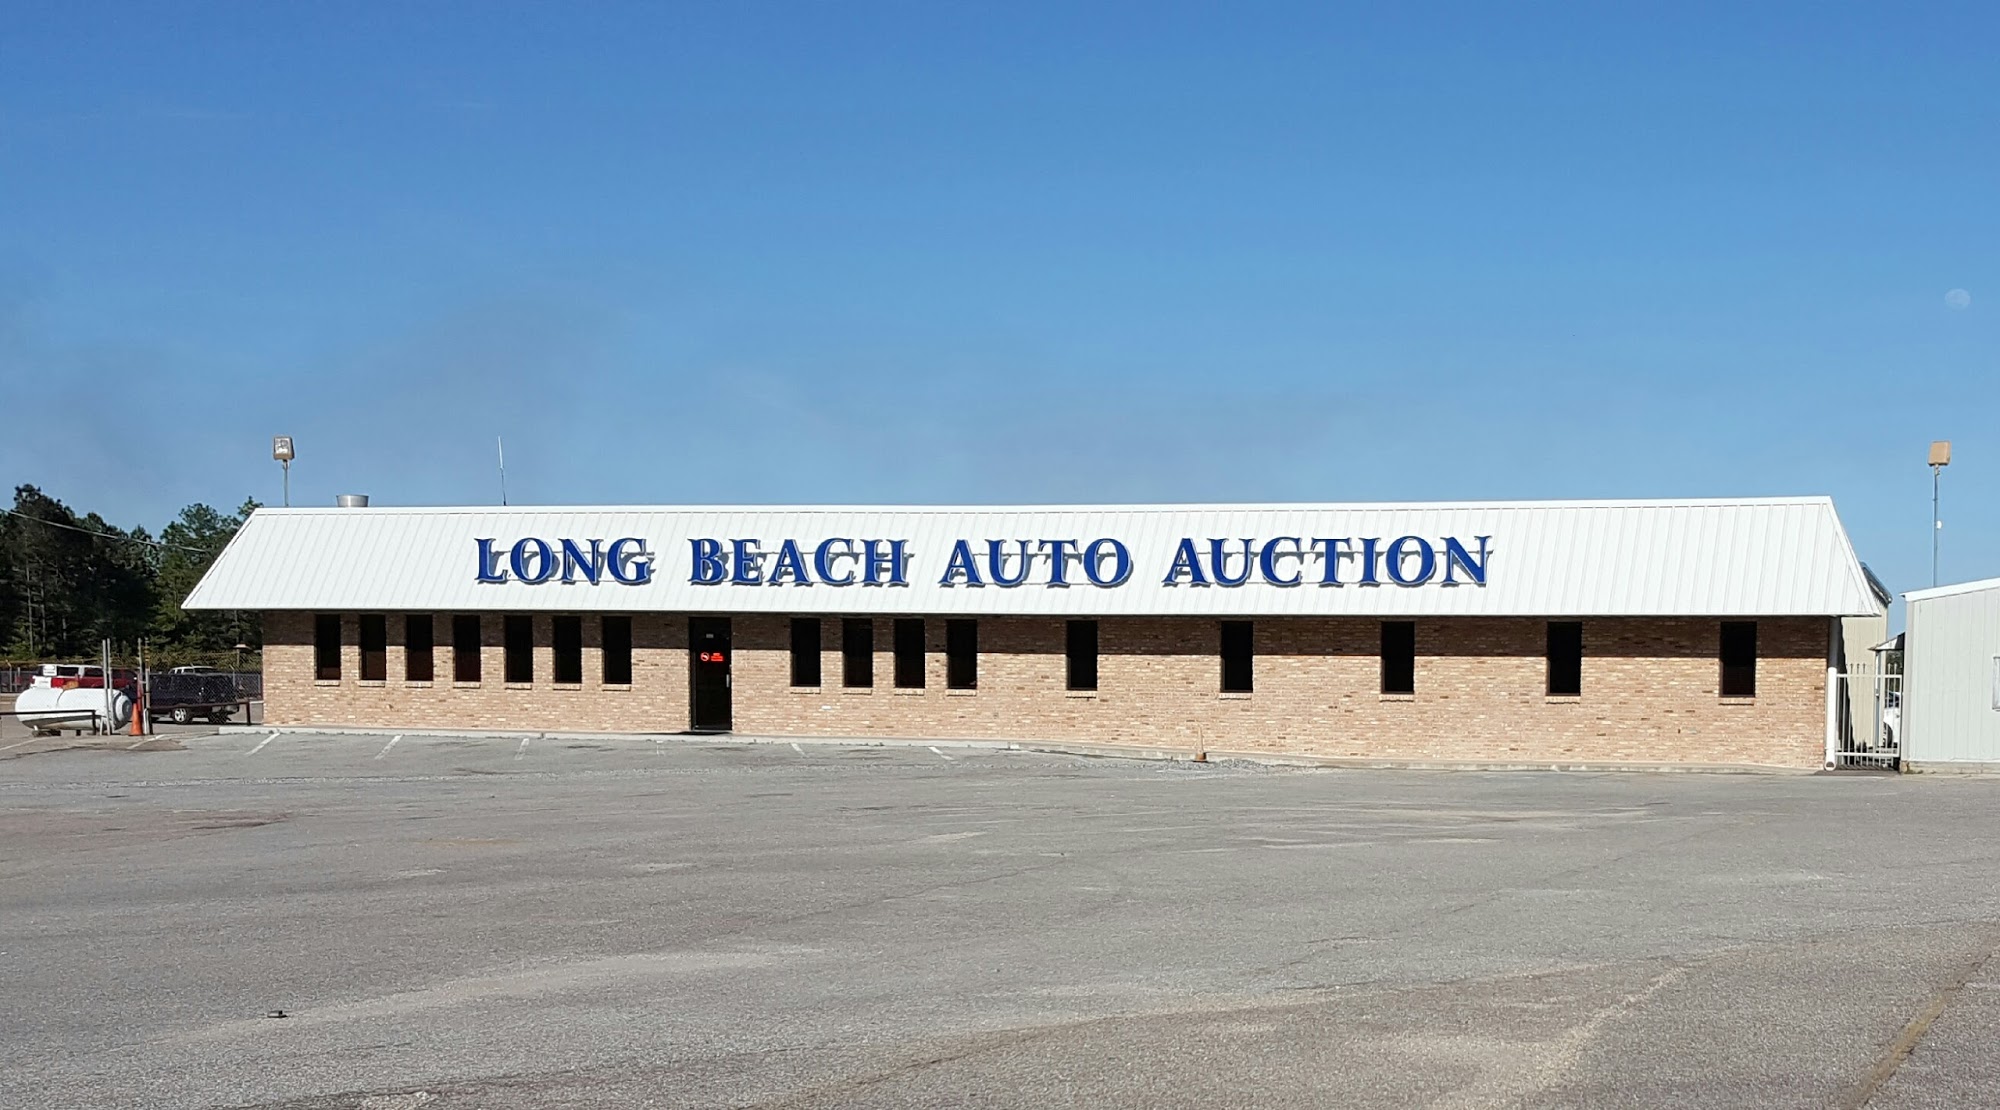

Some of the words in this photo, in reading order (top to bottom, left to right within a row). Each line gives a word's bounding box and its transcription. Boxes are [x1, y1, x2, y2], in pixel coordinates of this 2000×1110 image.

[475, 538, 651, 585] LONG
[688, 537, 908, 586] BEACH
[940, 537, 1131, 586] AUTO
[1162, 535, 1490, 586] AUCTION
